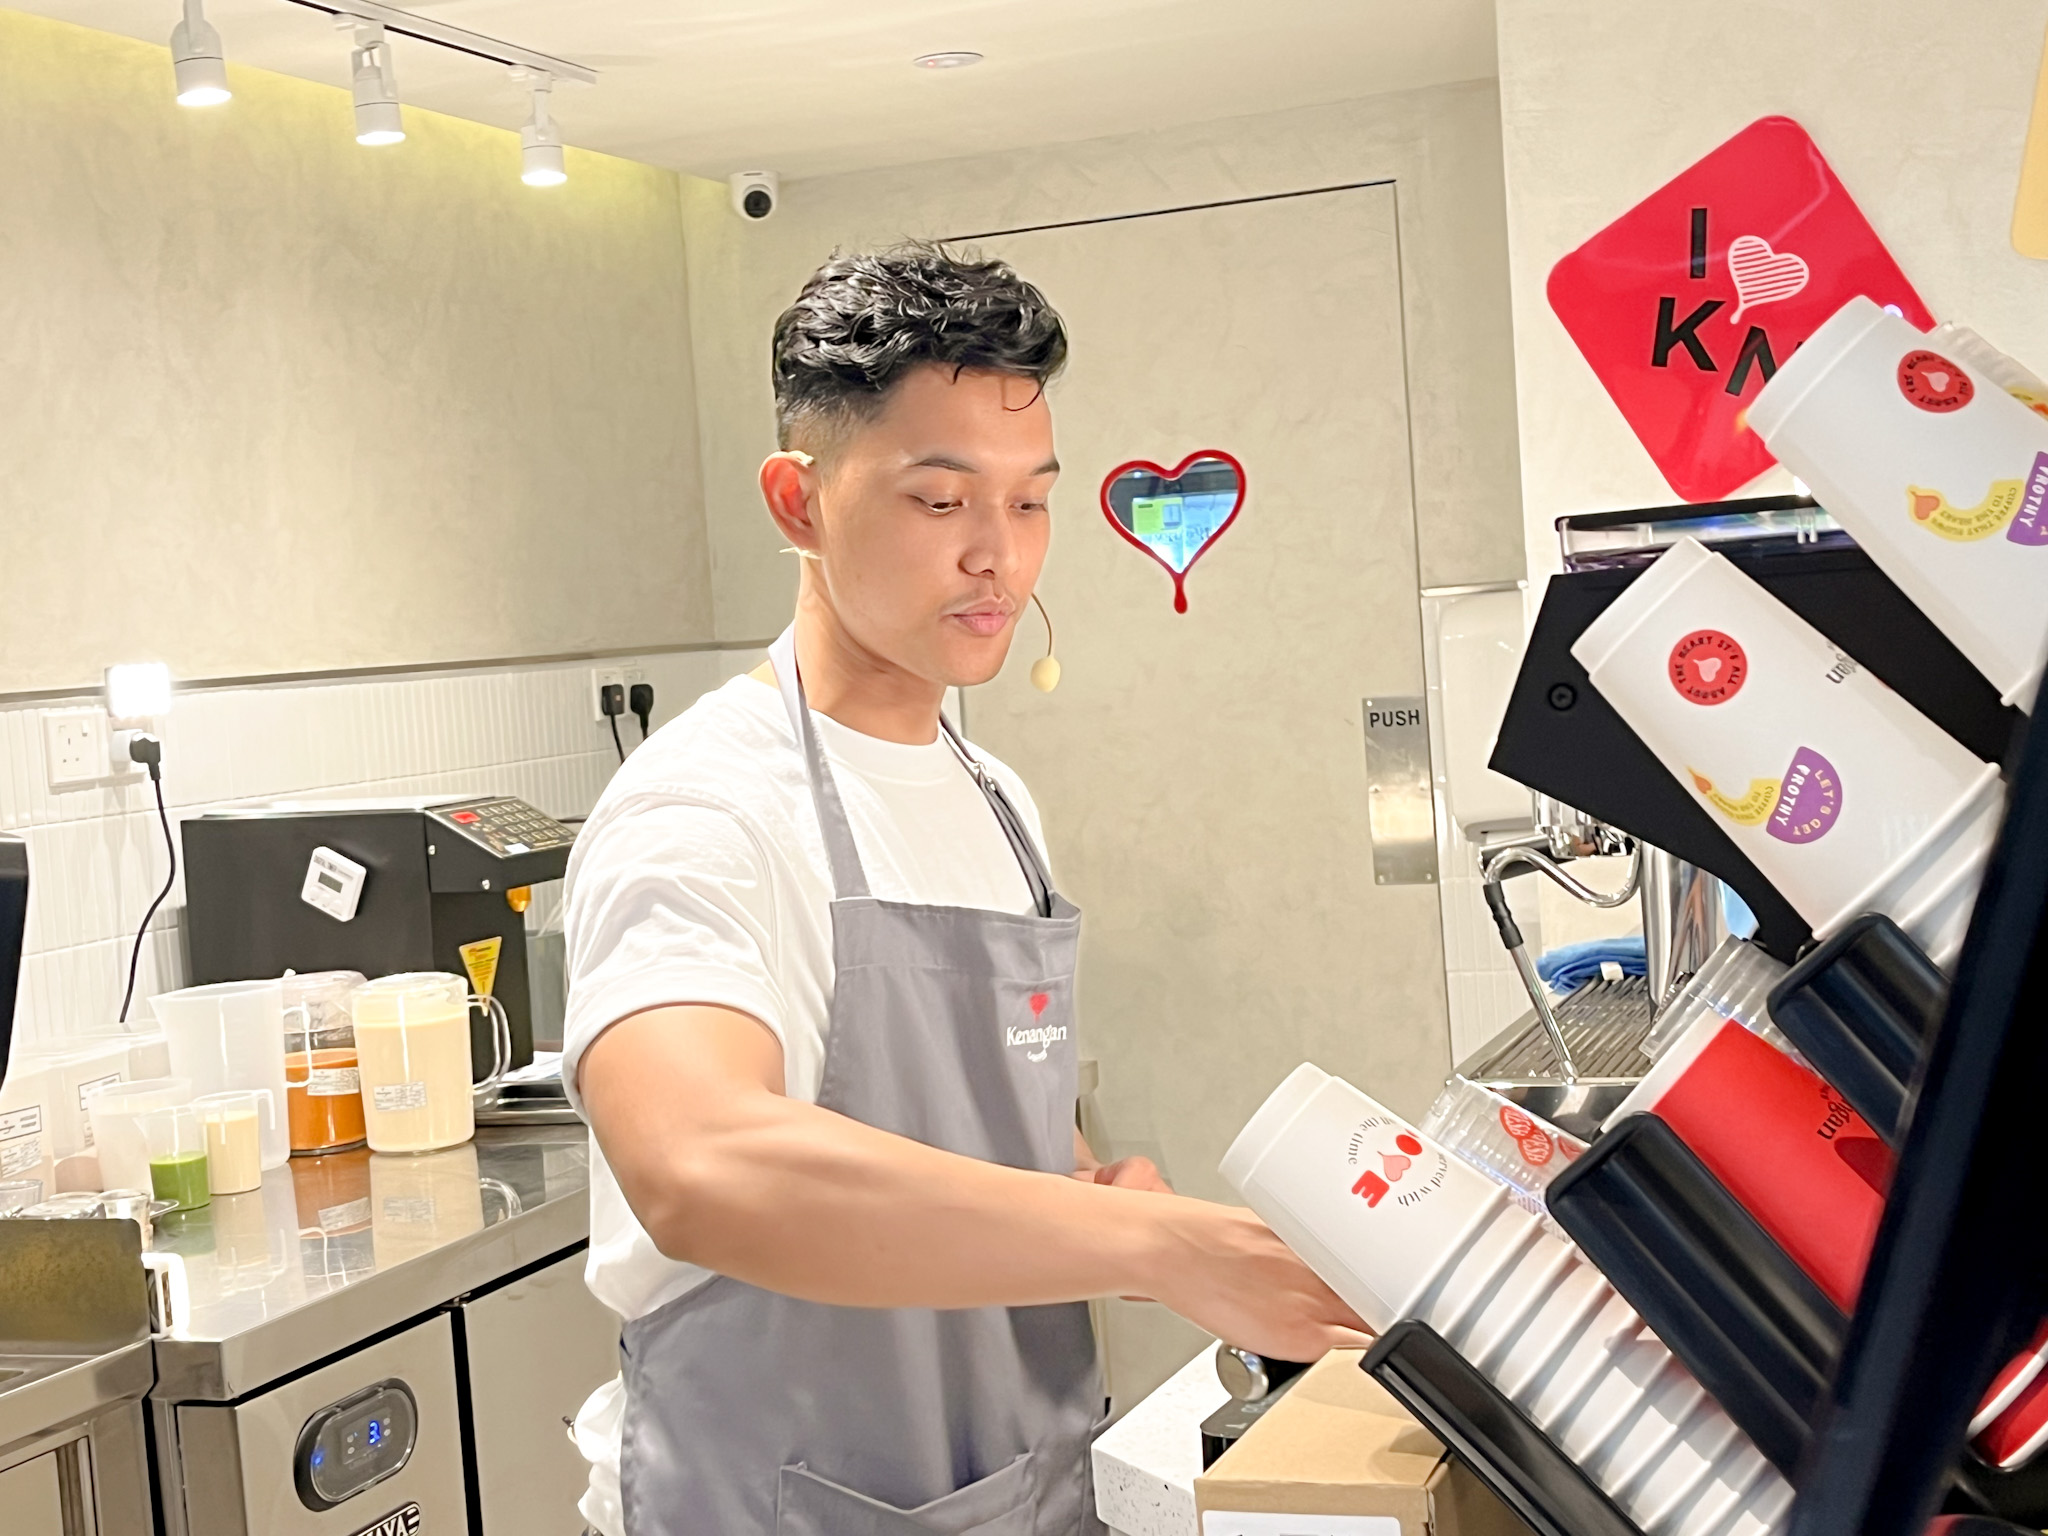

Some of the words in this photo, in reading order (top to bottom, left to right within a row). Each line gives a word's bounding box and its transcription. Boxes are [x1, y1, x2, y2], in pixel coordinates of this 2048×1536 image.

[1690, 208, 1707, 280] I
[1651, 297, 1804, 397] KA
[1369, 709, 1420, 729] PUSH
[1006, 1024, 1067, 1062] Kenangan
[1360, 1116, 1379, 1131] the
[1348, 1132, 1363, 1166] time
[1397, 1186, 1431, 1207] with
